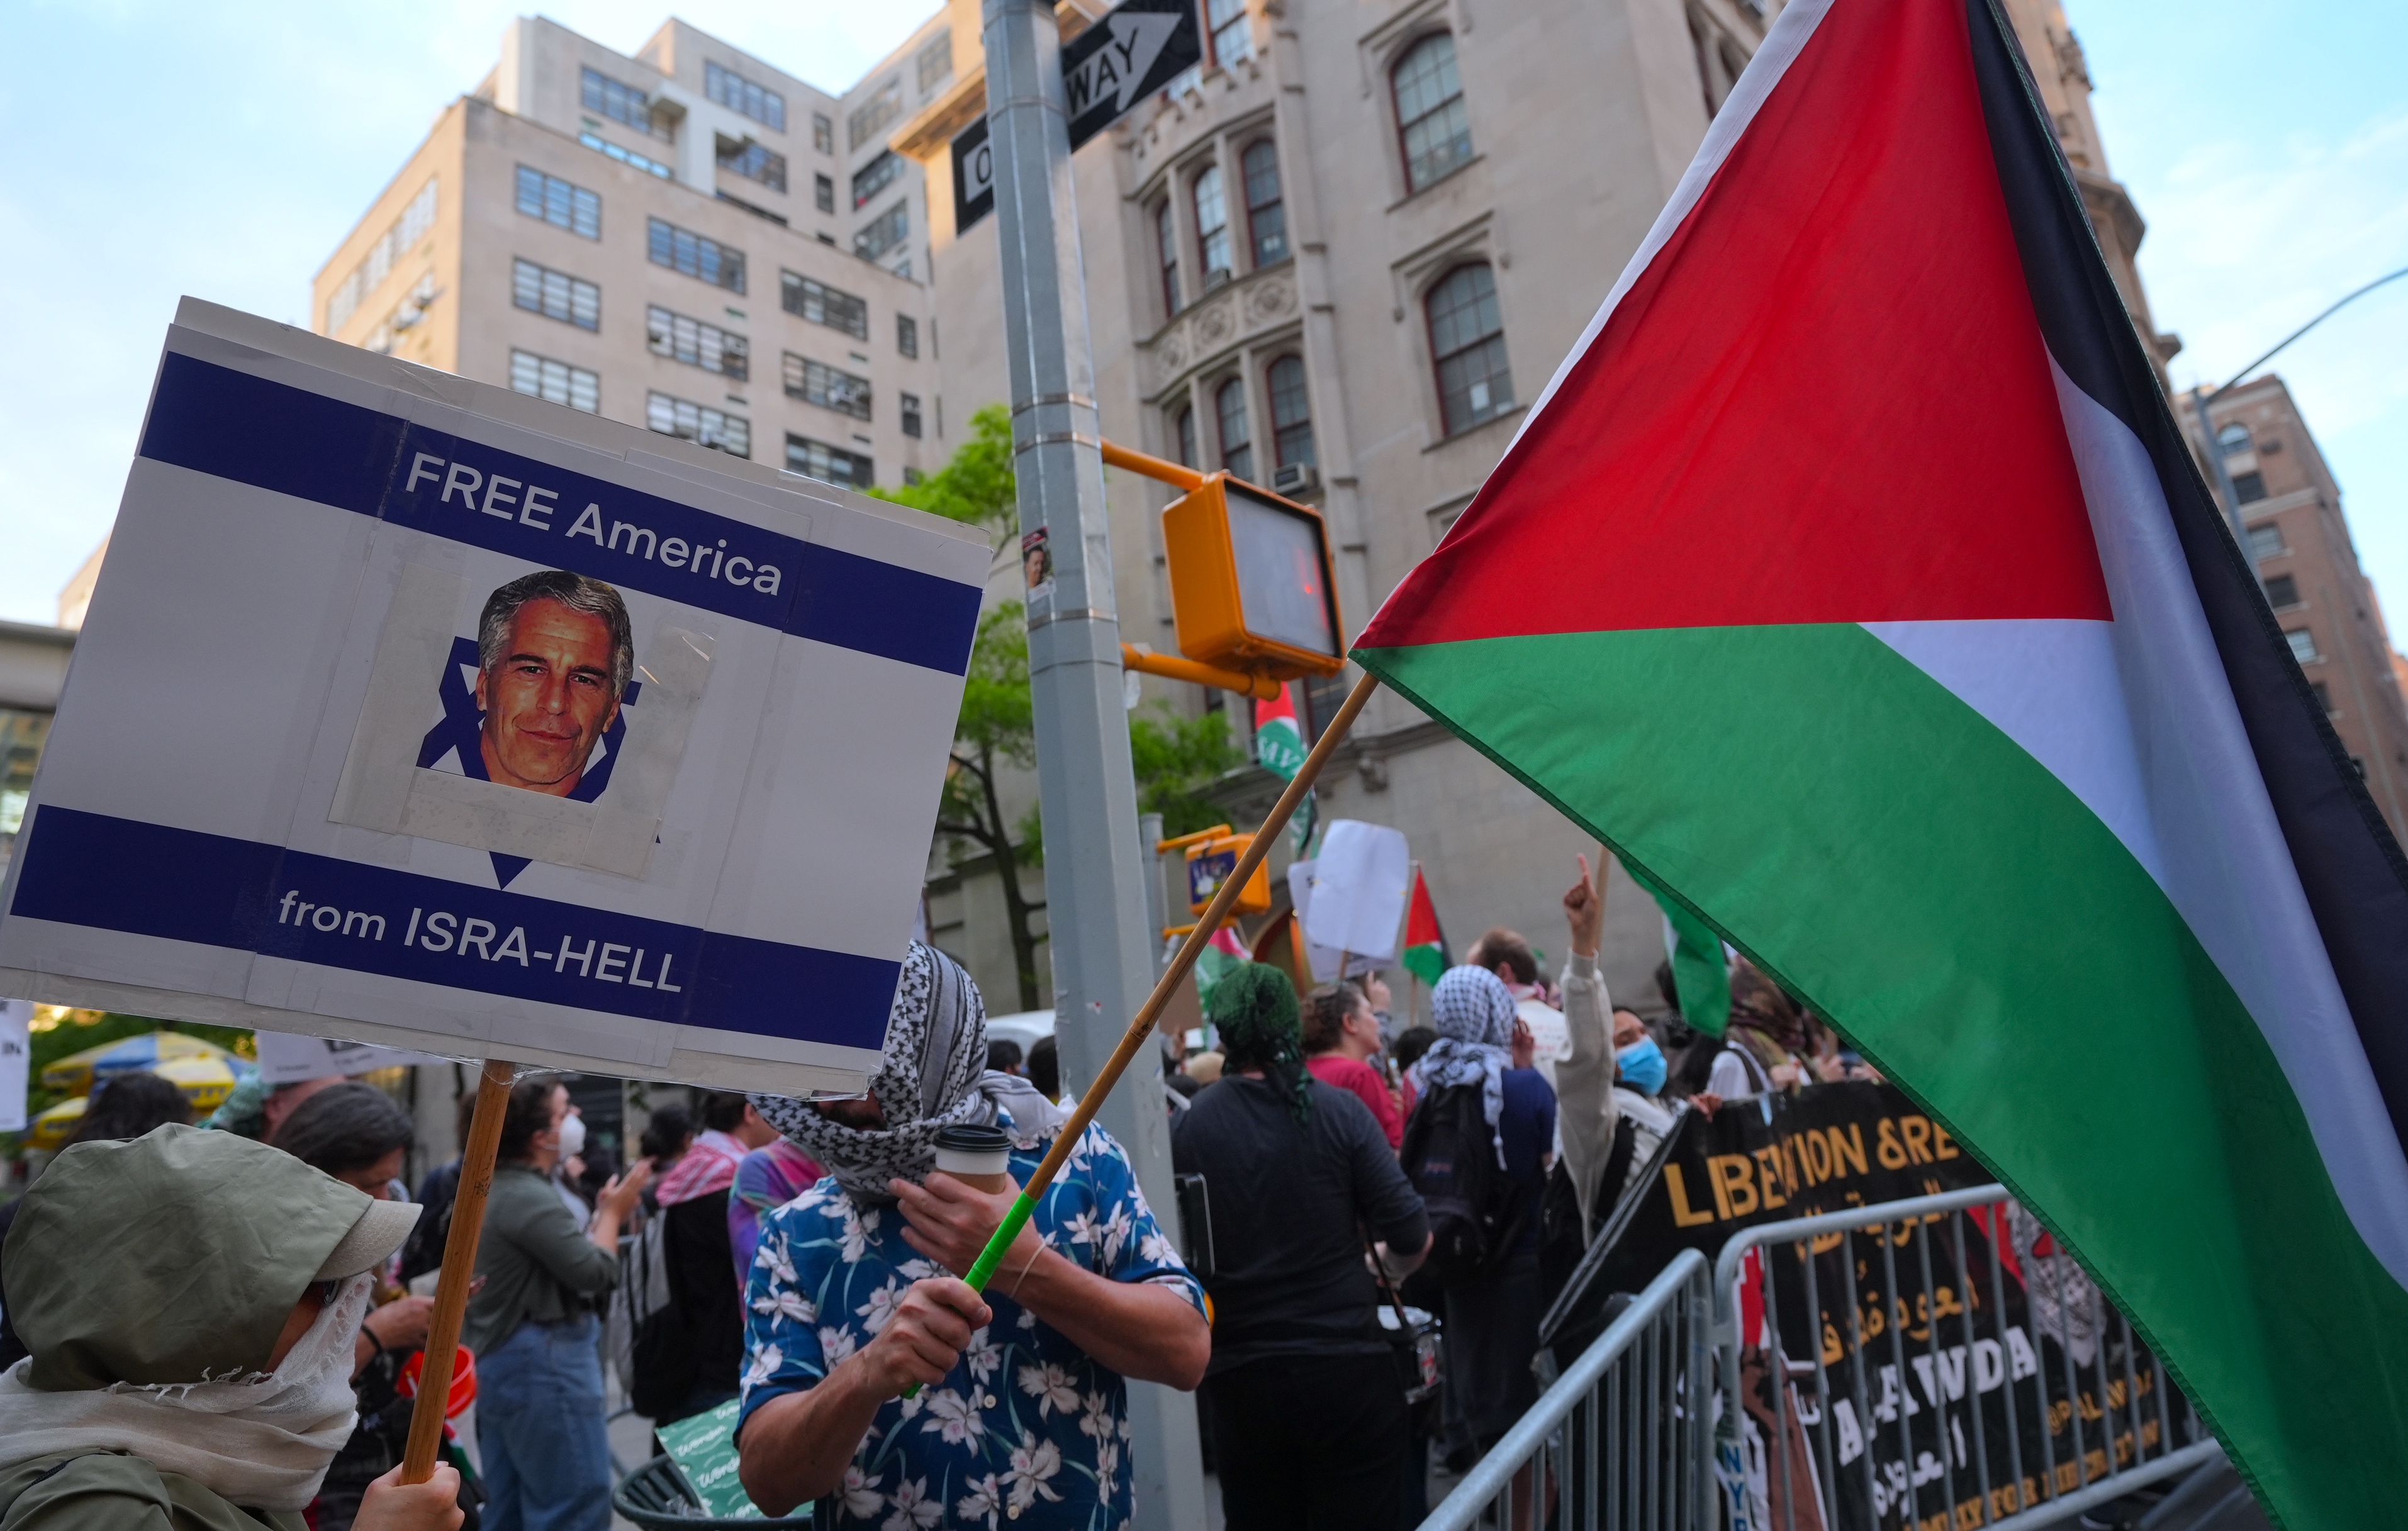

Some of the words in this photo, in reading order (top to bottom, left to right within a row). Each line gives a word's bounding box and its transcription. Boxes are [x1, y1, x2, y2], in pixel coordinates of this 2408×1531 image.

[1065, 26, 1140, 115] WAY
[405, 451, 559, 531] FREE
[564, 502, 782, 597] America
[278, 890, 386, 941] from
[403, 907, 683, 992] ISRA-HELL
